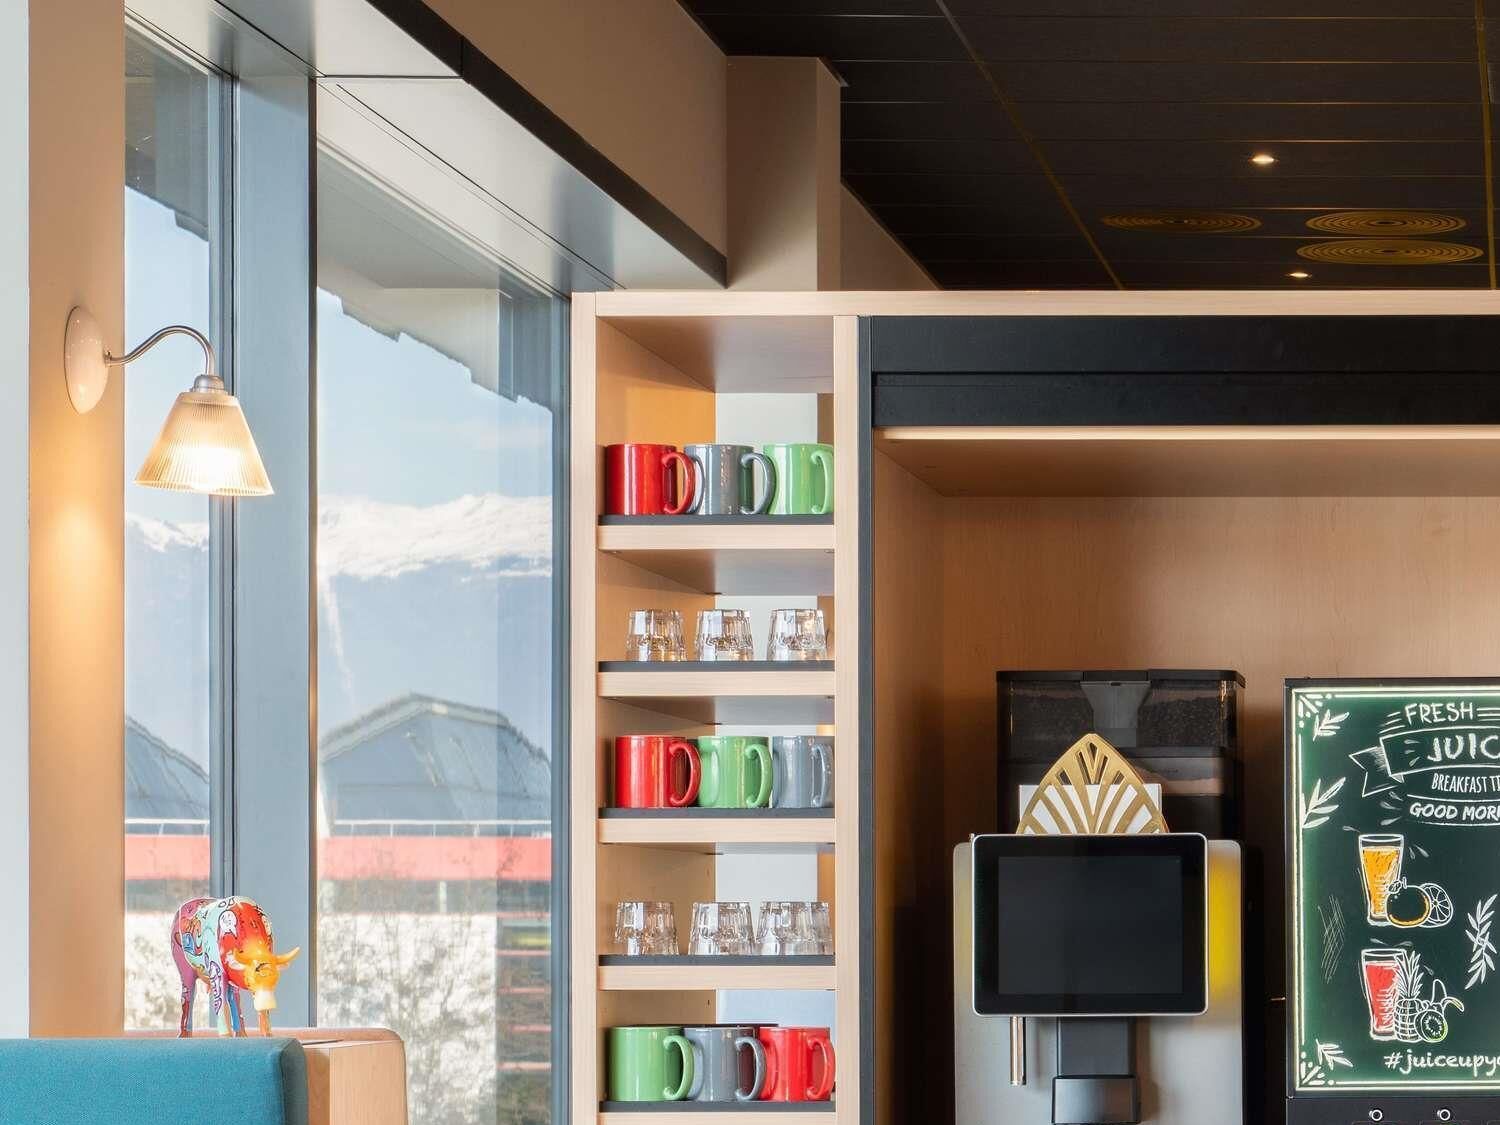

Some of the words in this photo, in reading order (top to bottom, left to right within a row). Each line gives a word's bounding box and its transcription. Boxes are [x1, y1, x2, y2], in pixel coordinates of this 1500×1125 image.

[1404, 701, 1474, 725] FRESH
[1431, 772, 1488, 793] BREAKFAST
[1409, 802, 1458, 819] GOOD
